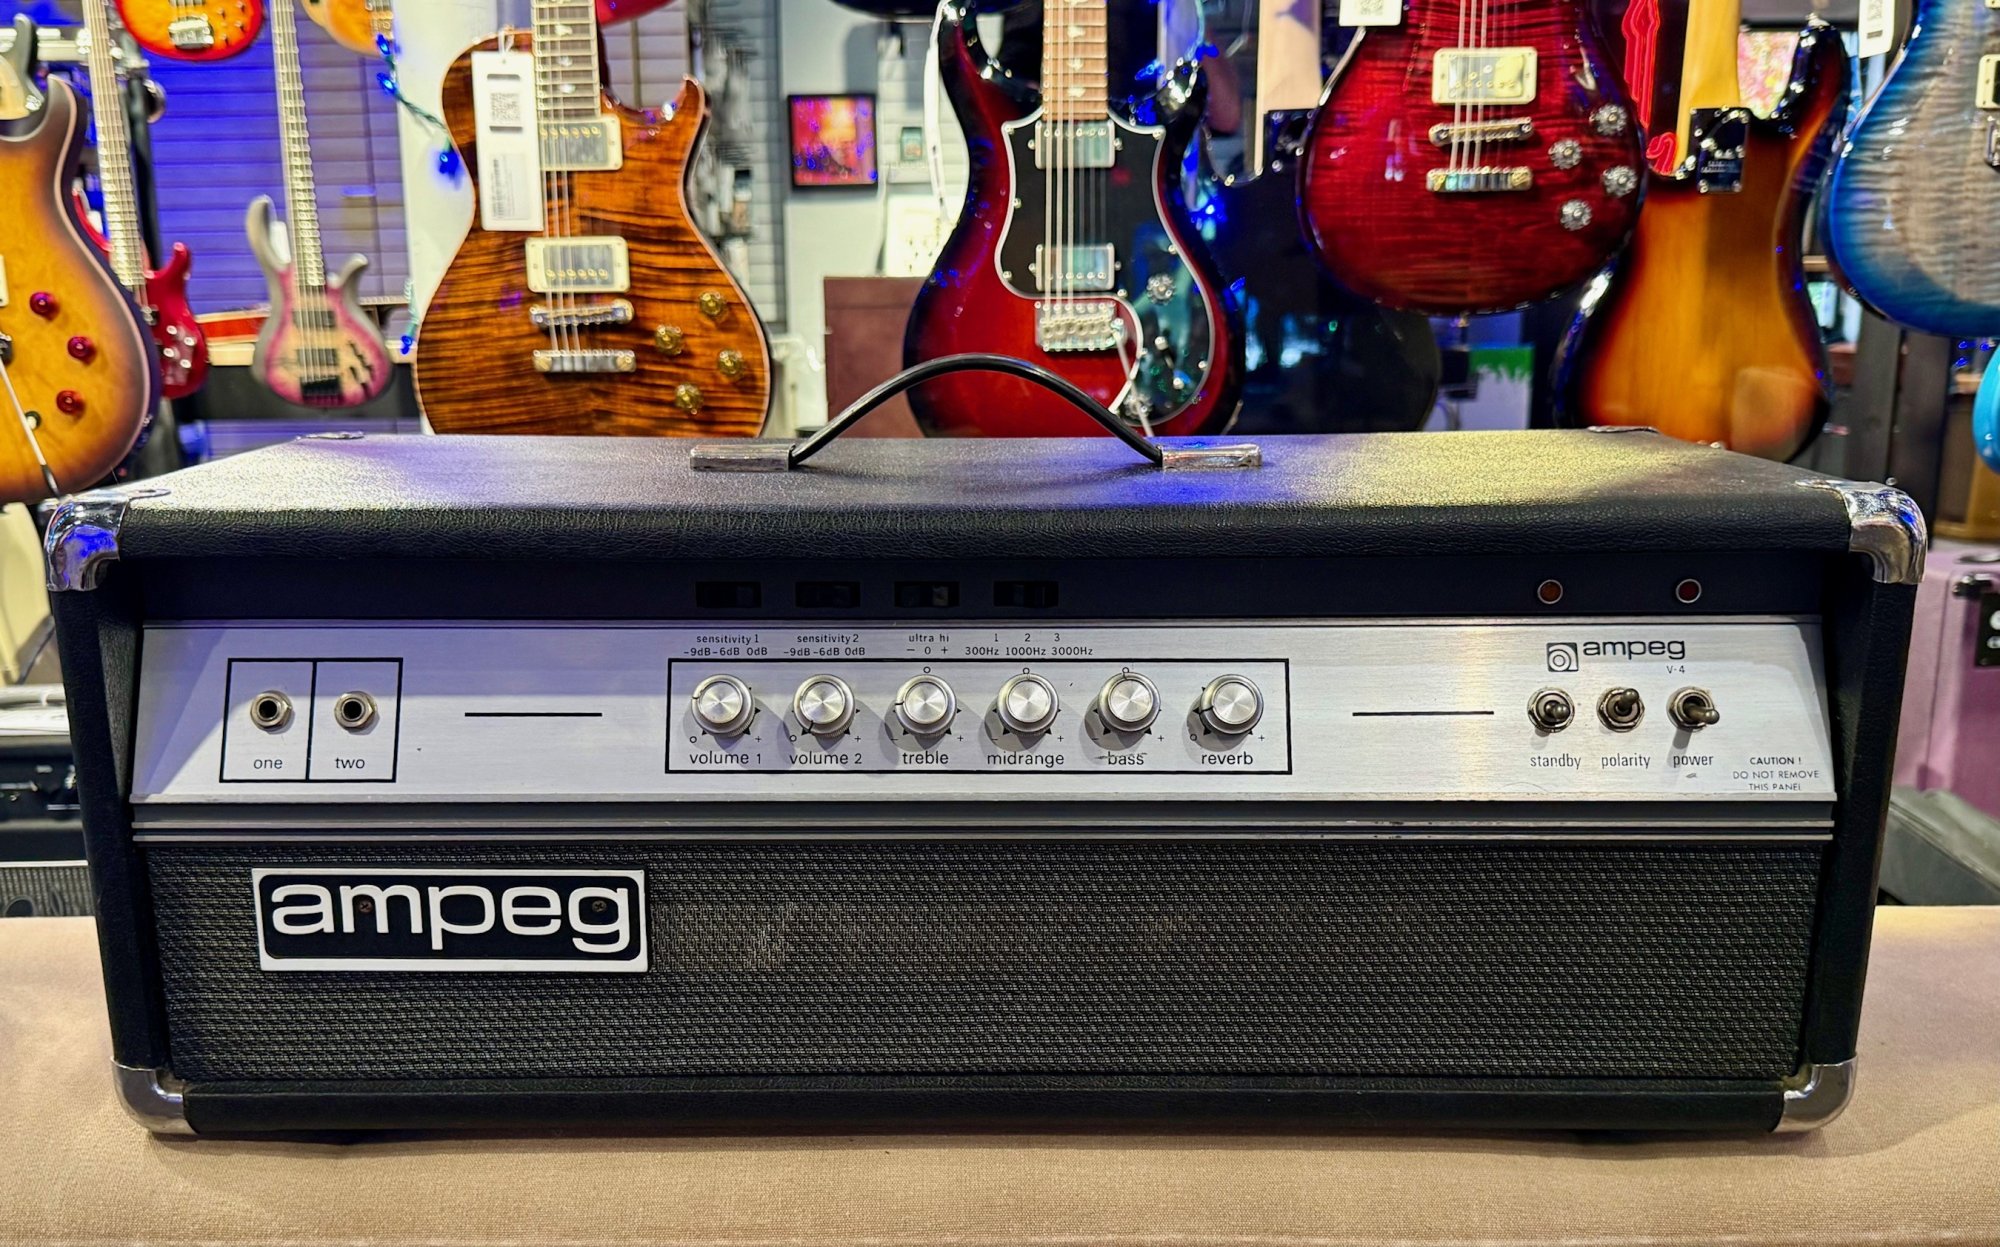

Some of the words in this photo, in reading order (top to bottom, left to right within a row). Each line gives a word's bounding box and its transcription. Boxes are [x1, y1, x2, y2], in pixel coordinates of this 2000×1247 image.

[696, 634, 751, 645] sensitivity
[754, 634, 760, 644] 1
[796, 633, 851, 645] sensitivity
[853, 633, 860, 644] 2
[908, 633, 935, 643] ultra
[939, 633, 950, 643] hi
[1024, 633, 1031, 643] 2
[1054, 633, 1061, 643] 3
[746, 647, 768, 657] 0dB
[844, 647, 866, 657] 0dB
[965, 646, 1000, 656] 300Hz
[1005, 646, 1047, 656] 1000Hz
[1051, 646, 1093, 656] 3000Hz
[1583, 640, 1686, 660] ampeg
[1665, 665, 1686, 675] V-4
[253, 757, 283, 770] one
[335, 757, 365, 770] two
[689, 752, 749, 765] volume
[756, 753, 762, 765] 1
[789, 752, 848, 765] volume
[854, 752, 862, 765] 2
[902, 752, 949, 765] treble
[987, 751, 1065, 768] midrange
[1107, 751, 1145, 766] bass
[1200, 751, 1254, 765] reverb
[1530, 753, 1582, 769] standby
[1601, 753, 1651, 769] polarity
[1673, 755, 1714, 767] power
[1749, 757, 1795, 765] CAUTION
[1732, 771, 1749, 779] DO
[1752, 771, 1774, 779] NOT
[1778, 770, 1820, 779] REMOVE
[1748, 783, 1769, 791] THIS
[271, 883, 631, 954] ampeg
